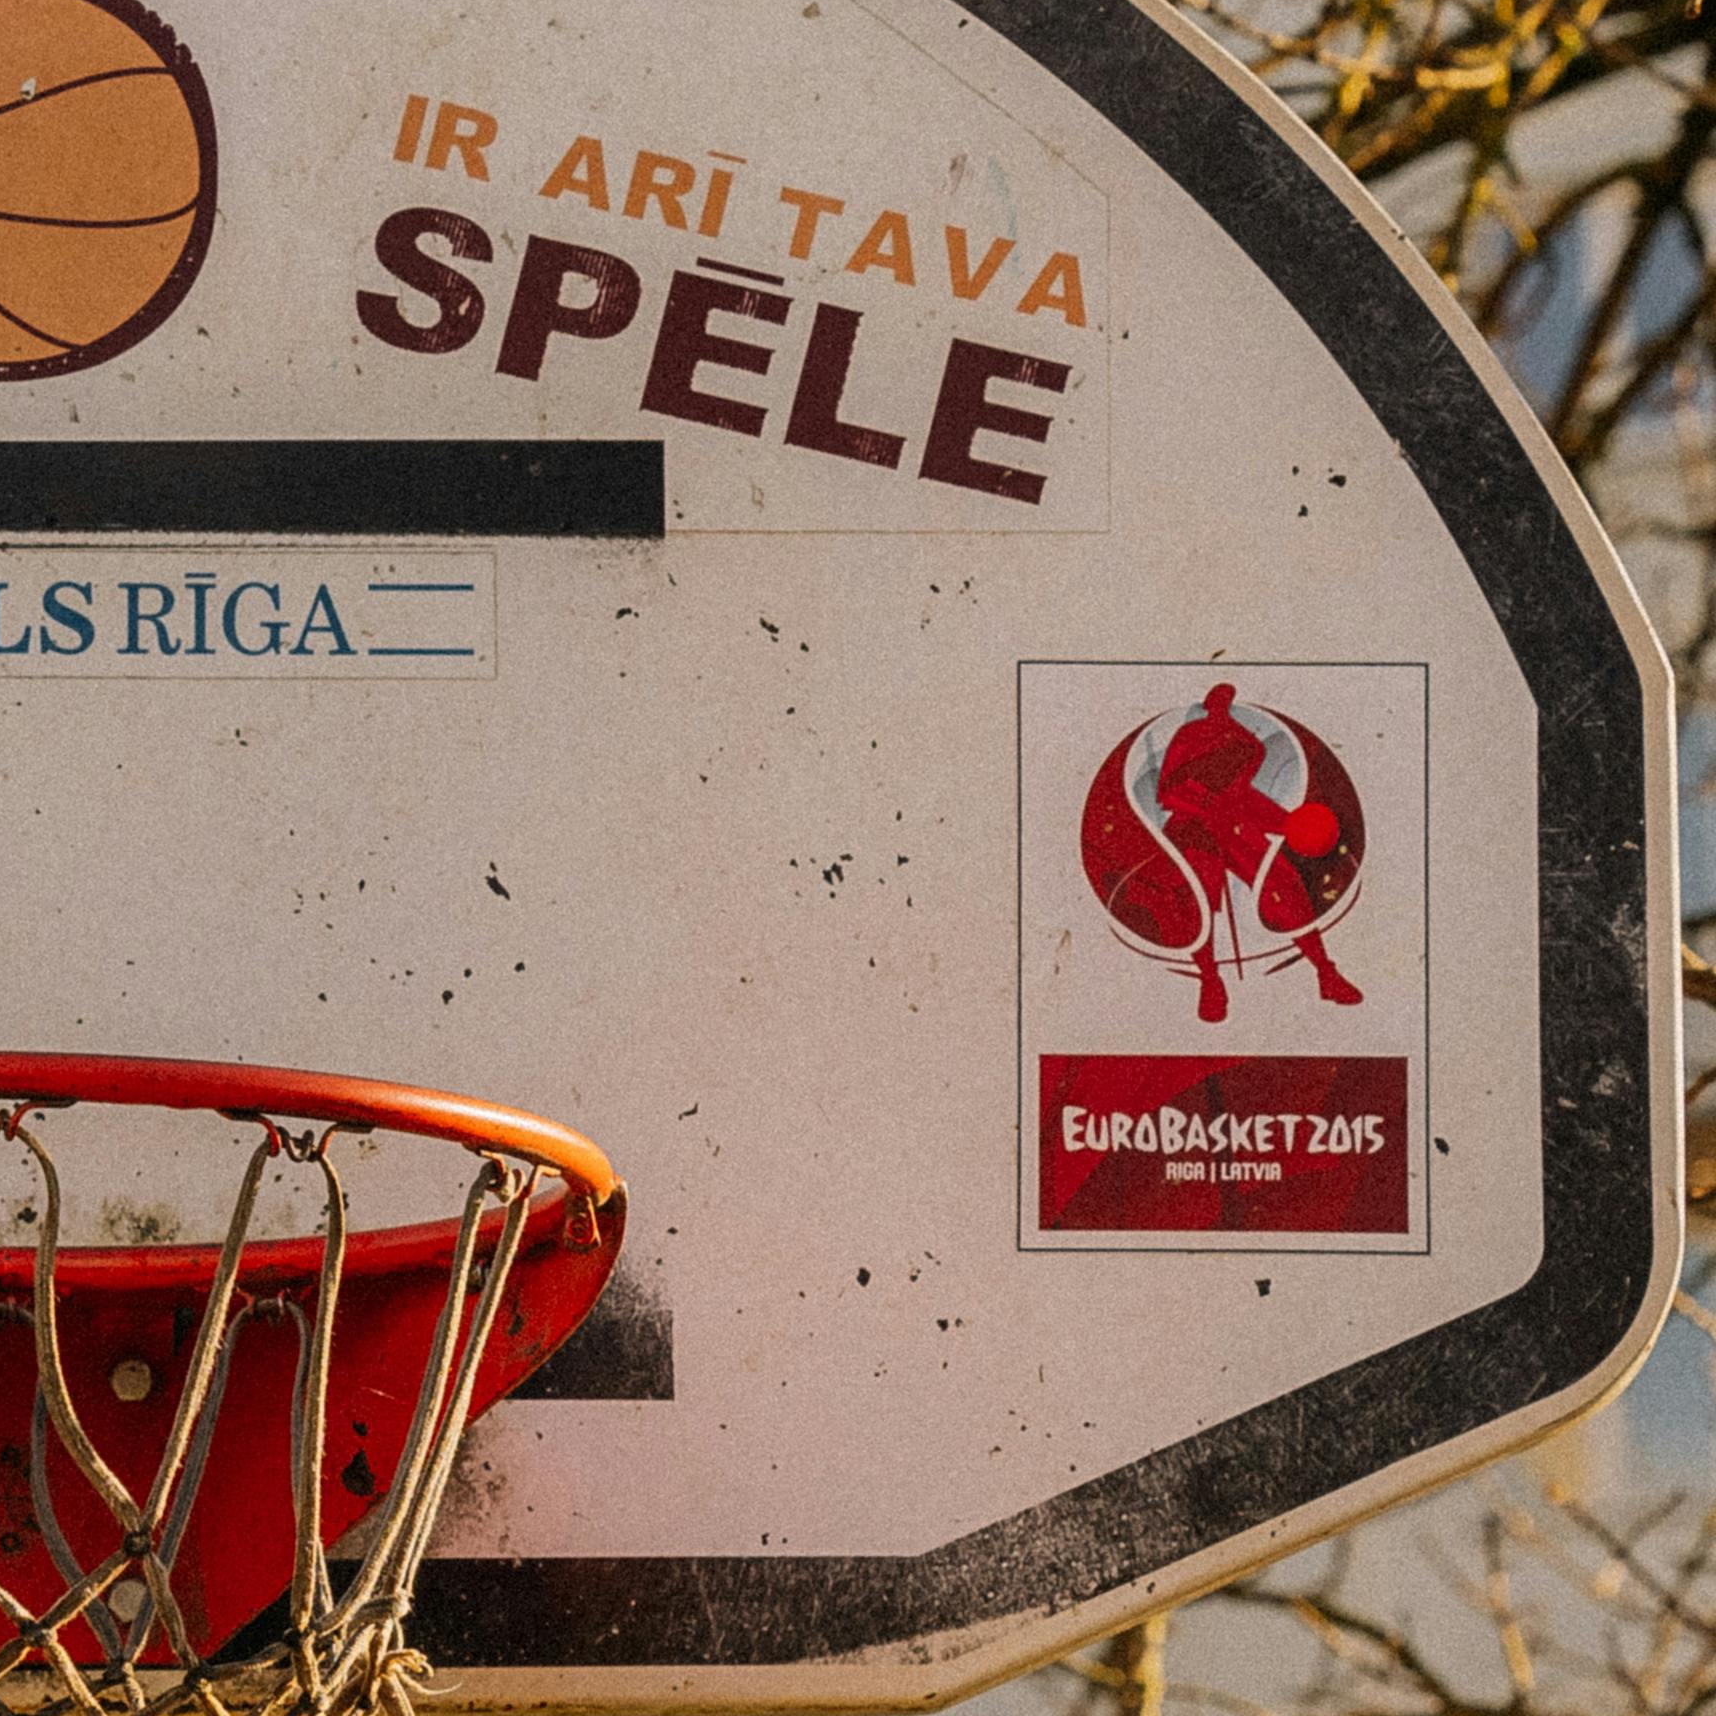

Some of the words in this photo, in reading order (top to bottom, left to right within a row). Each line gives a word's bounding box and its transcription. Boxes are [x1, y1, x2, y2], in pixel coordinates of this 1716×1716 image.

[393, 94, 499, 182] IR
[539, 135, 748, 238] ARĪ
[779, 186, 1088, 329] TAVA
[355, 206, 1073, 506] SPĒLE
[117, 571, 358, 657] RĪGA
[1164, 1160, 1206, 1182] RIGA
[1220, 1160, 1283, 1182] LATVIA
